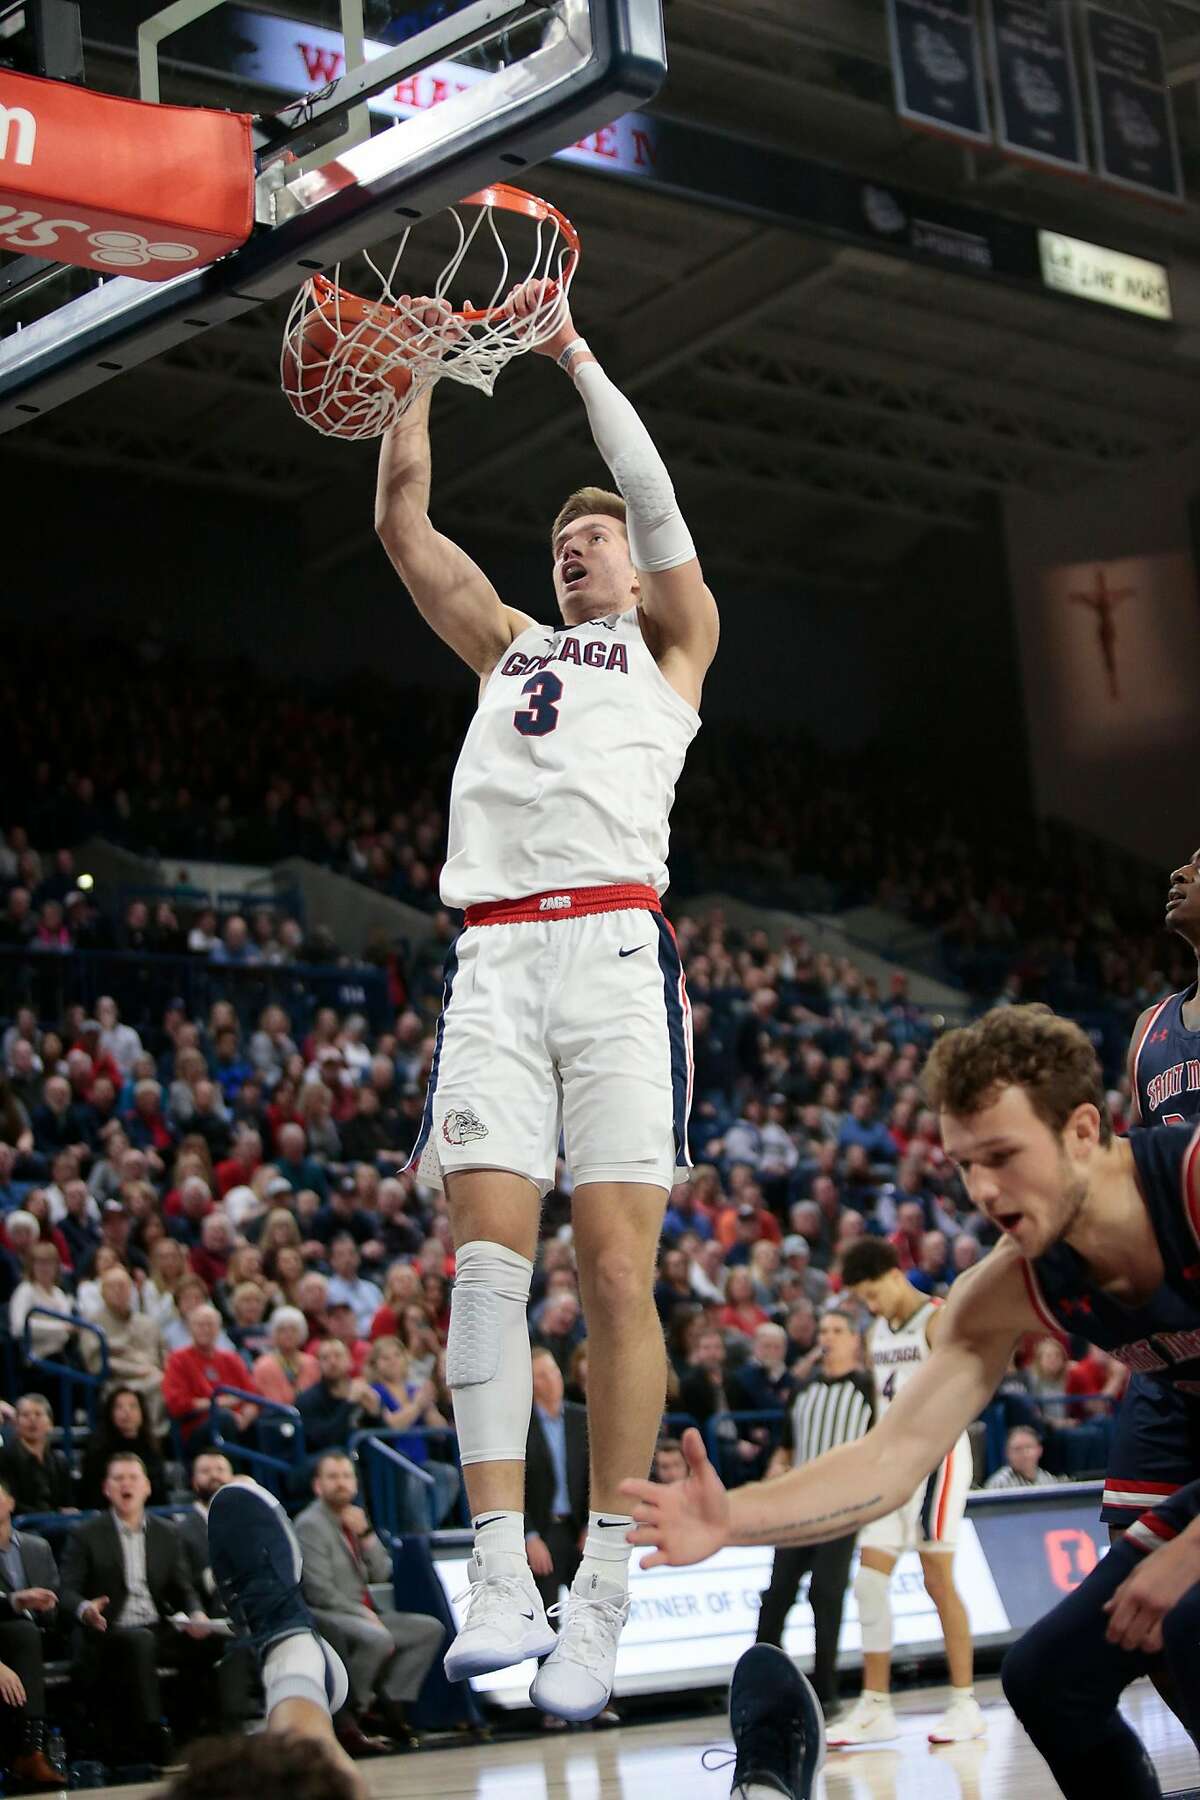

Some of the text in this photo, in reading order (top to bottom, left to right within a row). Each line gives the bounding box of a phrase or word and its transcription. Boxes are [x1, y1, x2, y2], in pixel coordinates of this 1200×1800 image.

[501, 637, 629, 676] GOAGA
[513, 670, 563, 737] 3
[539, 895, 572, 911] ZAGS
[1147, 1063, 1184, 1112] SAINT
[882, 1370, 897, 1402] 4
[706, 1590, 733, 1614] OF
